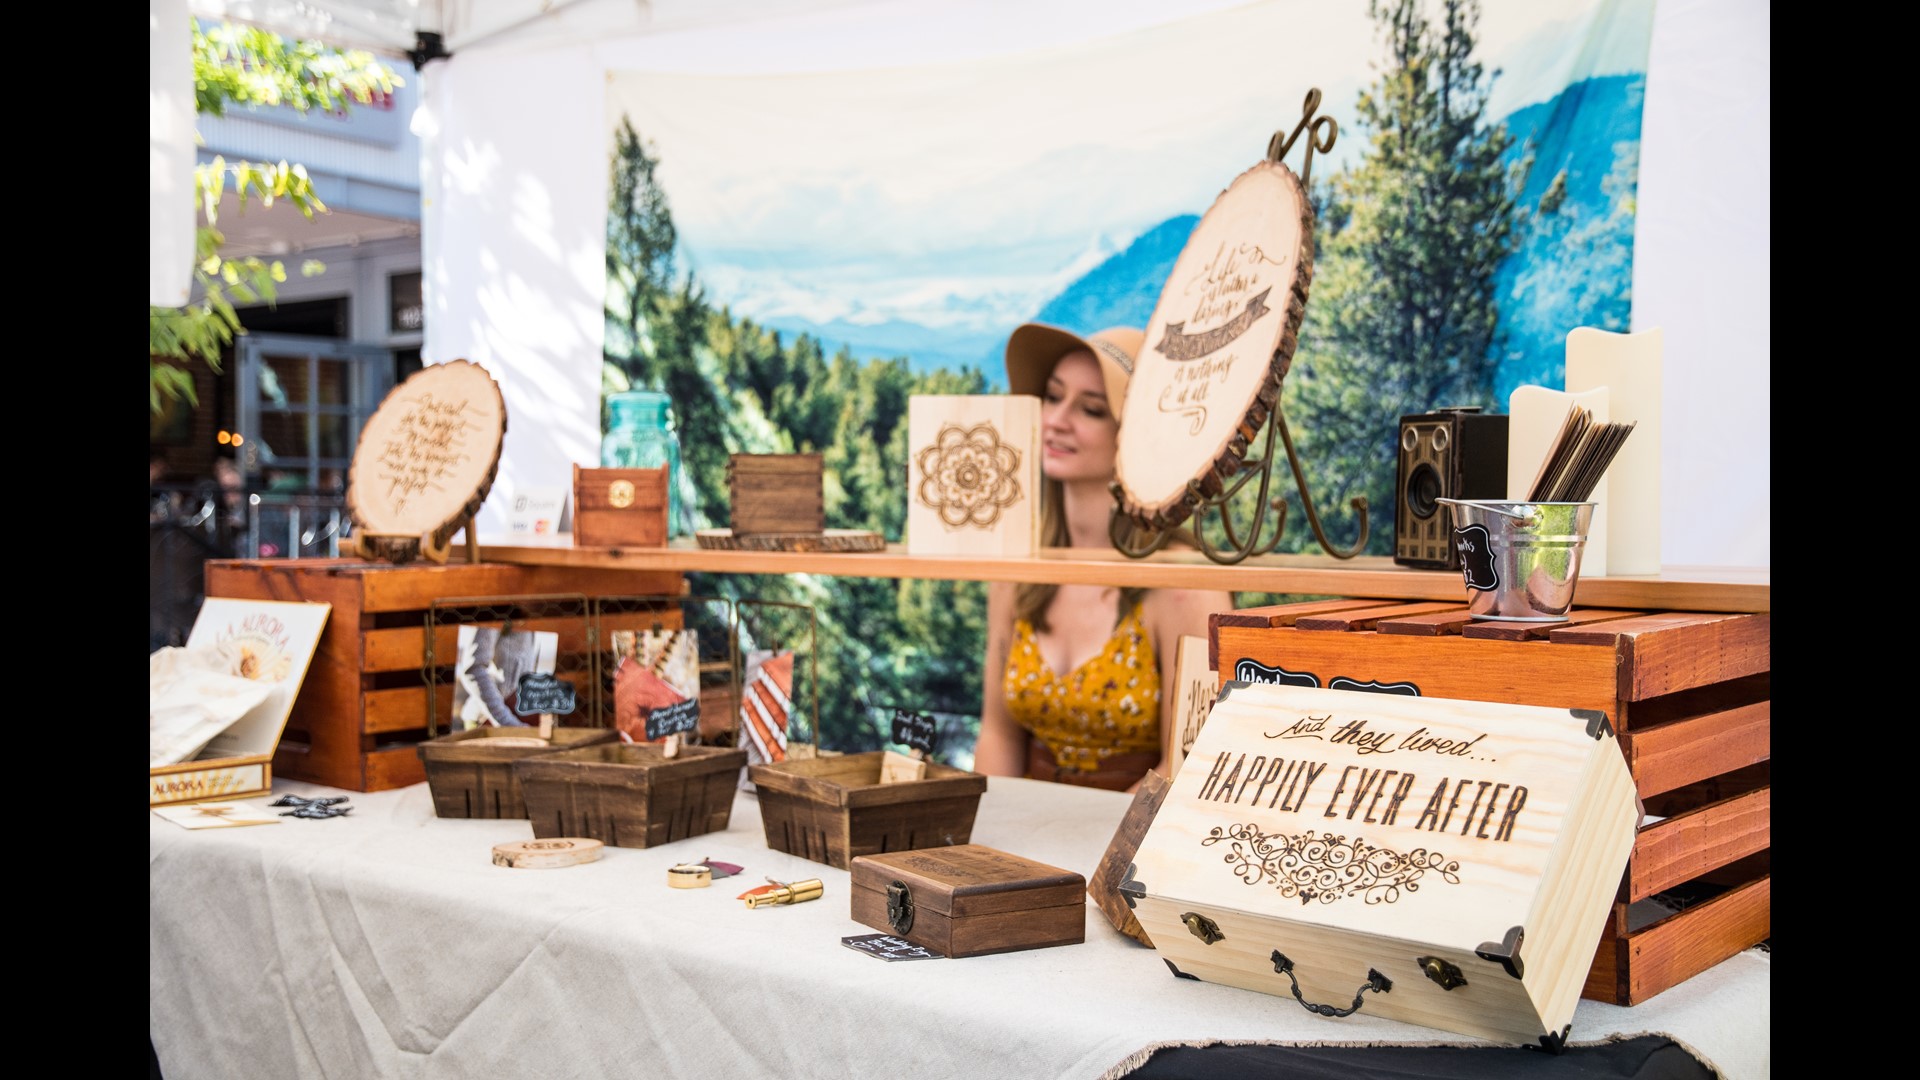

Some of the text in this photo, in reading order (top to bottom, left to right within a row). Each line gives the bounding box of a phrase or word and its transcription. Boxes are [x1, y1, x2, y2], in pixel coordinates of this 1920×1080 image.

[1264, 714, 1497, 763] And they lived...
[153, 780, 204, 796] AURORA
[1197, 751, 1529, 842] HAPPILY EVER AFTER
